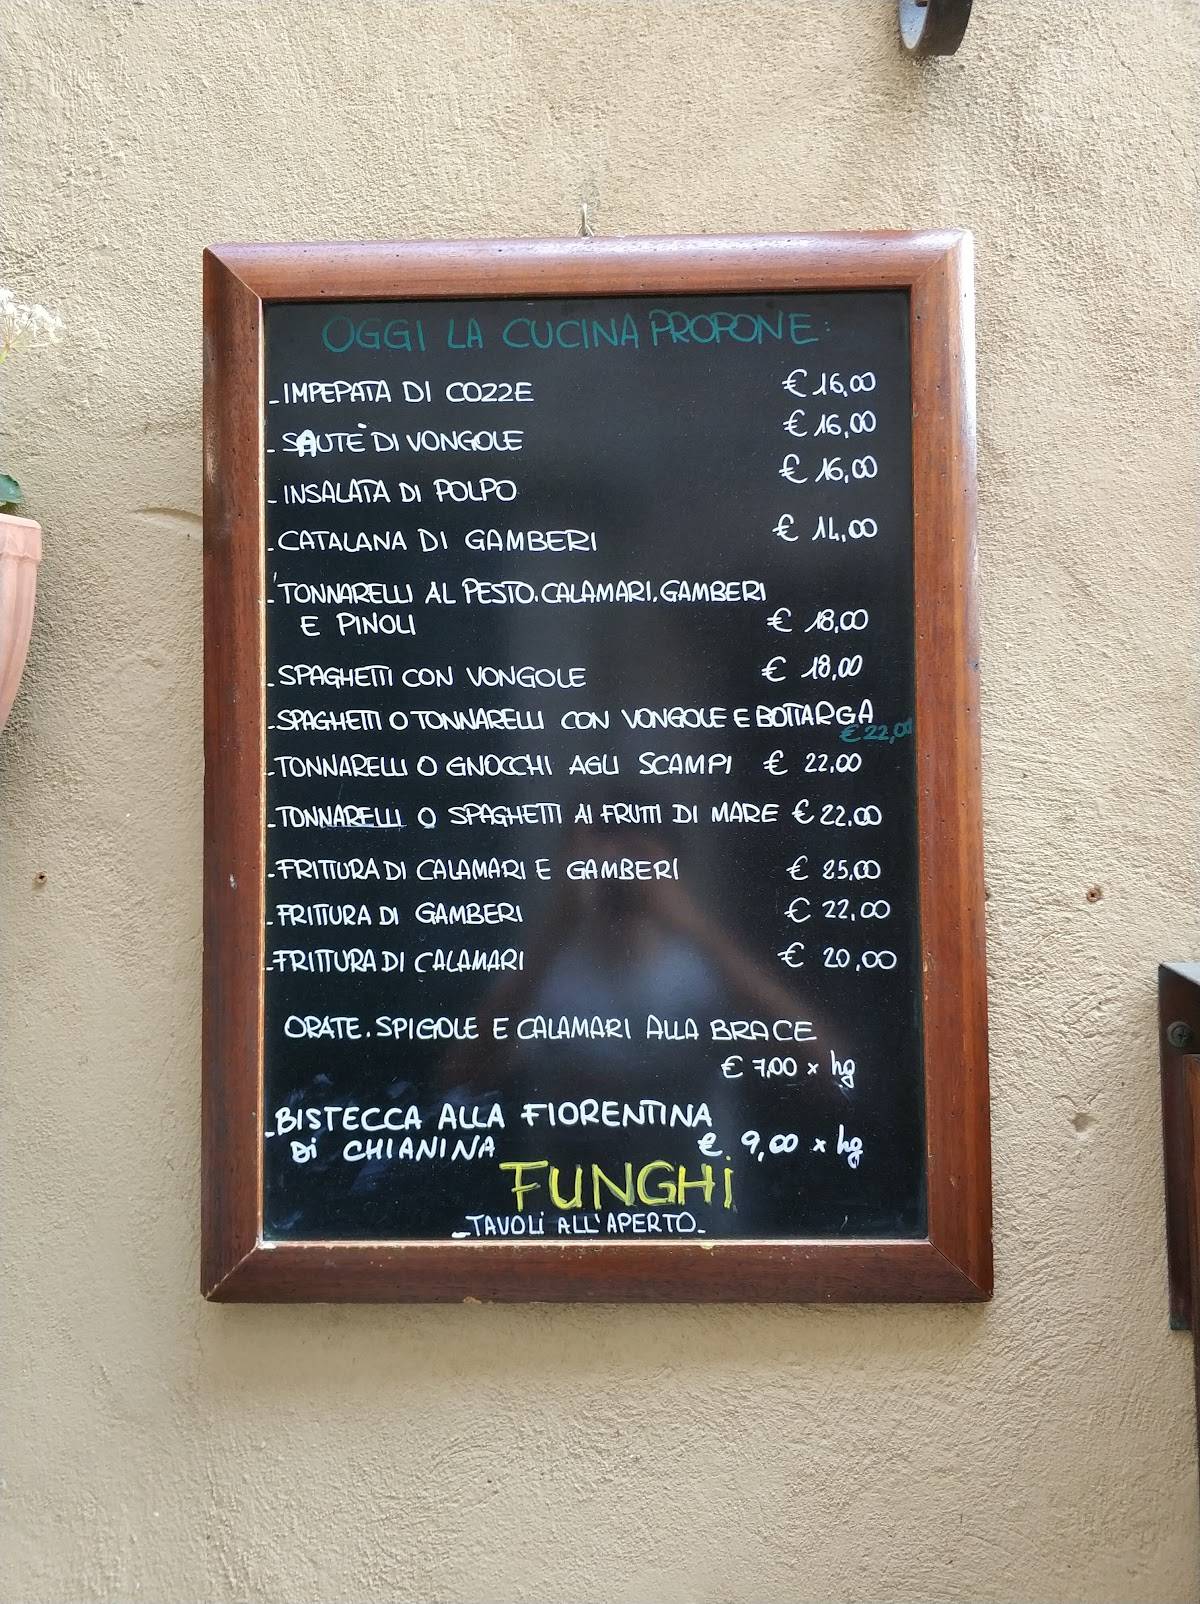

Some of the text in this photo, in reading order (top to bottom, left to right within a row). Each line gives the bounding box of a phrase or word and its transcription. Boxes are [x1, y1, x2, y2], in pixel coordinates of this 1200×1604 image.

[321, 317, 426, 351] OGGI
[448, 319, 483, 348] LA
[502, 317, 640, 350] CUCINA
[284, 380, 391, 403] IMPEPATA
[402, 381, 431, 402] DI
[782, 369, 876, 397] € 16,00
[783, 409, 876, 438] € 16,00
[371, 432, 399, 452] DI
[406, 430, 524, 451] VONGOLE
[779, 454, 877, 483] € 16,00
[284, 479, 391, 504] INSALATA
[399, 482, 421, 502] DI
[433, 478, 517, 502] POLPO
[278, 530, 407, 552] CATALANA
[418, 529, 448, 552] DI
[465, 529, 596, 551] GAMBERI
[772, 514, 877, 542] € 14,00
[277, 583, 413, 604] TONNARELLI
[425, 582, 456, 604] AL
[660, 580, 766, 602] GAMBERI
[301, 612, 416, 636] E PINOLI
[767, 608, 868, 633] € 18,00
[278, 664, 393, 689] SPAGHETTI
[402, 666, 453, 687] CON
[466, 666, 586, 688] VONGOLE
[762, 654, 862, 682] € 18,00
[389, 711, 408, 730] O
[410, 708, 544, 730] TONNARELLI
[561, 711, 609, 729] CON
[621, 707, 727, 729] VONGOLE
[734, 709, 750, 727] E
[756, 699, 873, 727] BOTTARGA
[417, 756, 437, 776] O
[446, 754, 552, 776] GNOCCHI
[569, 754, 619, 775] AGLI
[639, 752, 731, 775] SCAMPI
[763, 750, 788, 775] €
[418, 807, 436, 829] O
[448, 803, 562, 827] SPAGHETTI
[575, 803, 592, 824] AI
[600, 803, 661, 824] FRUTTI
[672, 804, 697, 823] DI
[712, 802, 779, 822] MARE
[792, 799, 814, 824] €
[383, 861, 406, 880] DI
[417, 858, 526, 880] CALAMARI
[535, 859, 551, 880] E
[567, 858, 678, 880] GAMBERI
[786, 855, 808, 880] €
[823, 860, 881, 880] 25,00
[276, 904, 371, 926] FRITTURA
[379, 906, 398, 925] DI
[415, 902, 523, 924] GAMBERI
[784, 897, 811, 923] €
[822, 899, 890, 921] 22,00
[381, 951, 404, 972] DI
[415, 949, 523, 972] CALAMARI
[777, 942, 804, 967] €
[823, 947, 897, 971] 20,00
[376, 1016, 479, 1039] SPIGOLE
[493, 1018, 509, 1039] E
[517, 1016, 631, 1039] CALAMARI
[647, 1015, 699, 1040] ALLA
[710, 1019, 817, 1041] BRACE
[721, 1056, 743, 1078] €
[831, 1050, 855, 1088] hg
[438, 1103, 505, 1130] ALLA
[521, 1099, 712, 1127] FIORENTINA
[343, 1135, 495, 1161] CHIANINA
[698, 1132, 723, 1156] €
[741, 1130, 798, 1162] 9,00
[837, 1124, 863, 1168] hg
